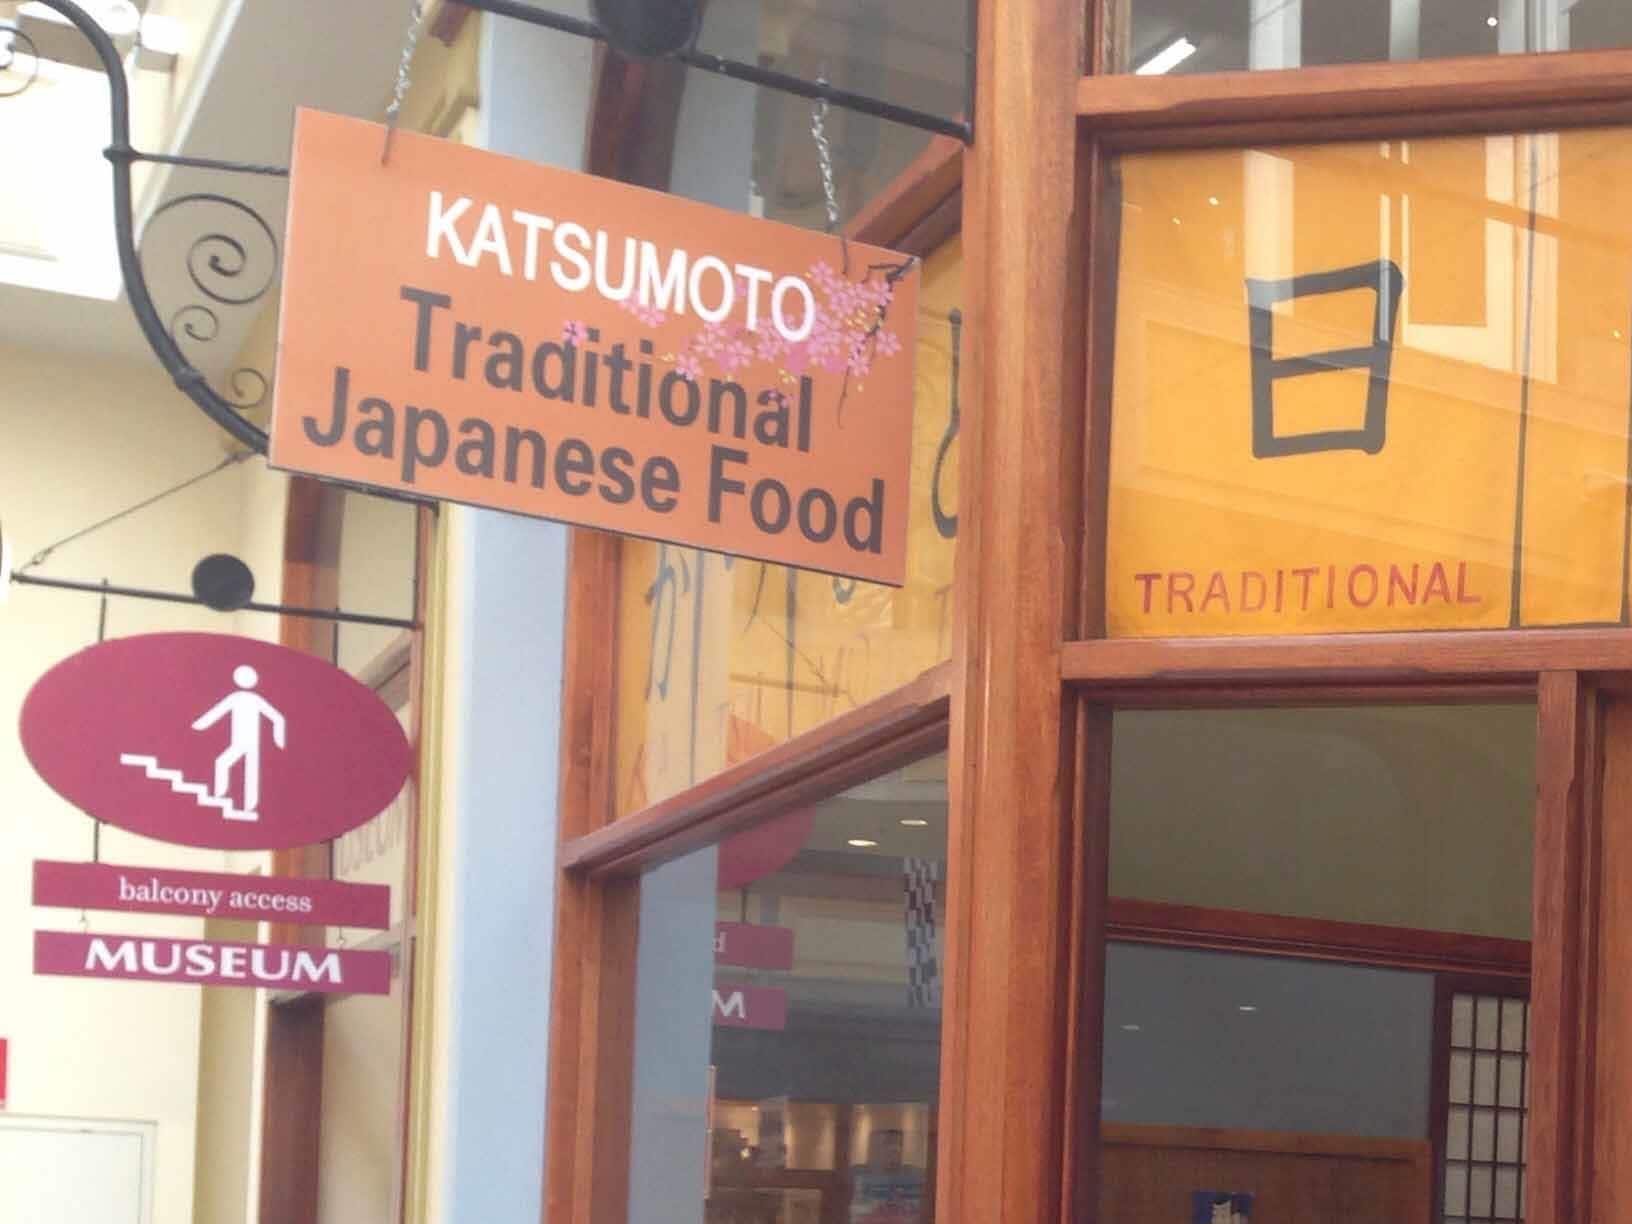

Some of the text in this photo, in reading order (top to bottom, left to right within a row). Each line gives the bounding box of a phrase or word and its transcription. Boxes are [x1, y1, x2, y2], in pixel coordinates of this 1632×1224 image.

[424, 190, 816, 342] KATSUMOTO
[399, 285, 815, 453] Traditional
[303, 366, 886, 556] Japanese Food
[1133, 560, 1483, 615] TRADITIONAL
[119, 876, 313, 914] balcony access
[85, 938, 343, 984] MUSEUM
